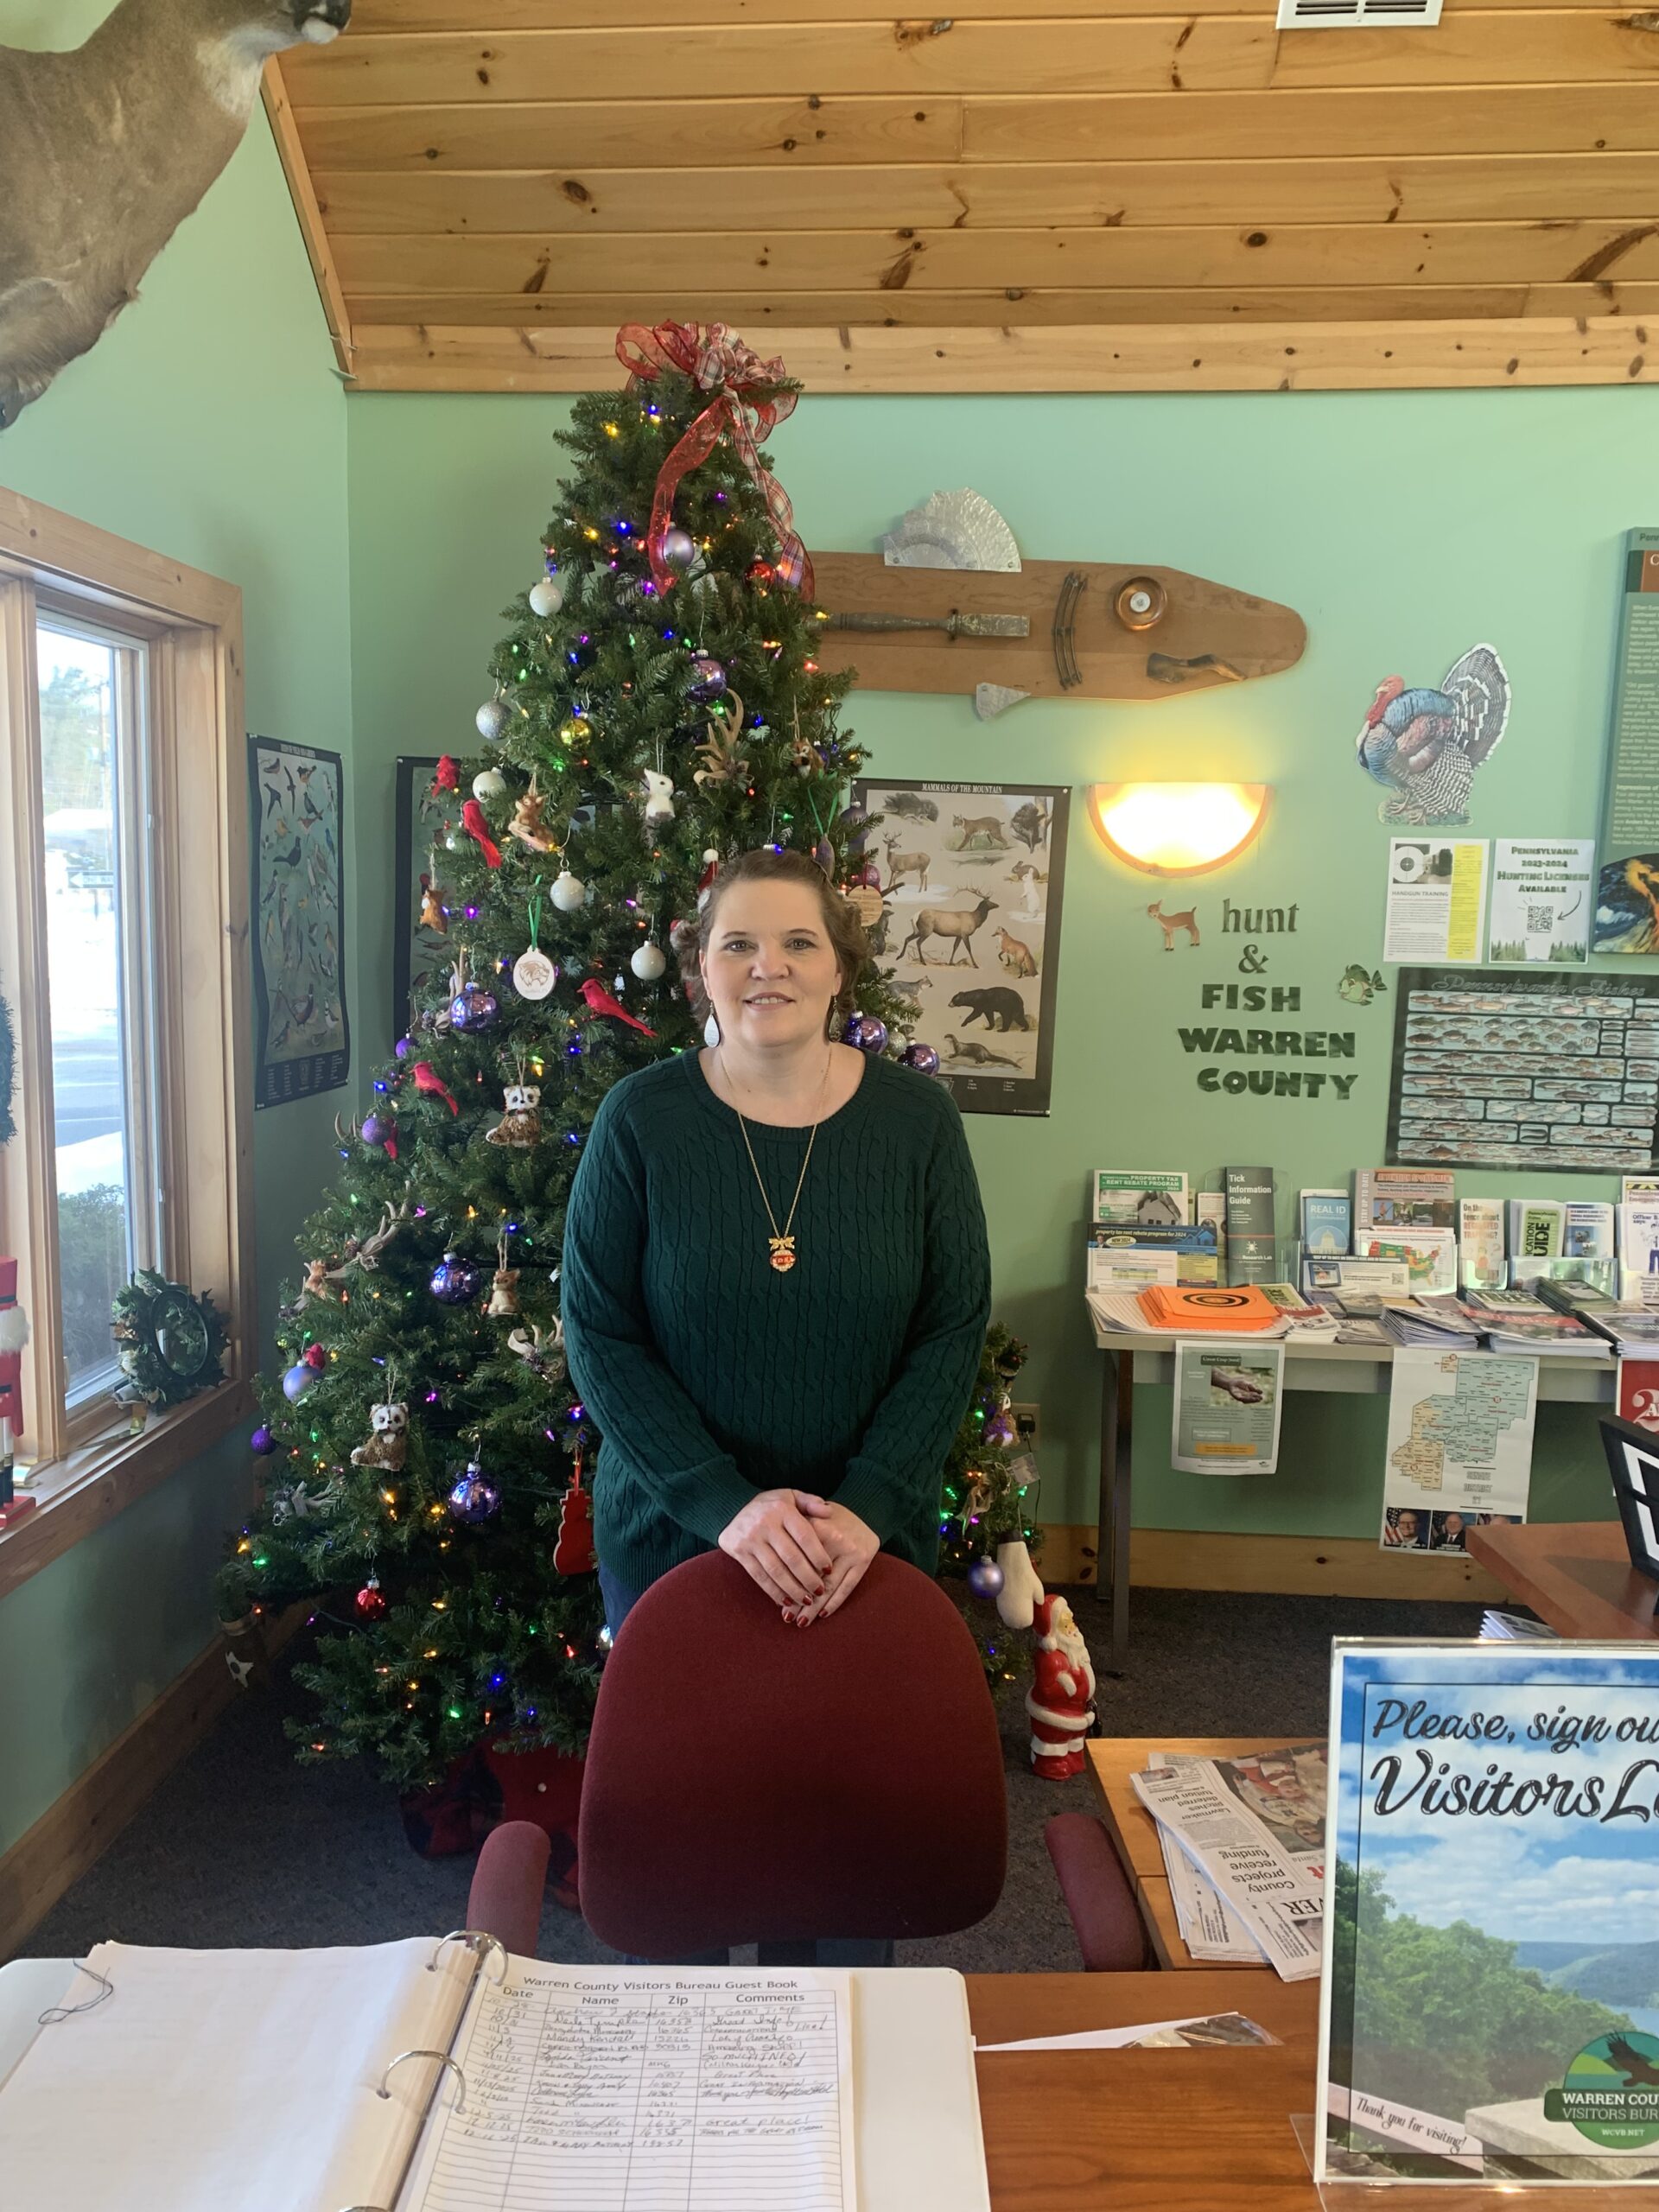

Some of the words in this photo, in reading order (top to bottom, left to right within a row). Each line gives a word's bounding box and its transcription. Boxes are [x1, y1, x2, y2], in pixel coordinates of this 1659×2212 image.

[921, 783, 950, 791] MAMMALS
[950, 784, 959, 792] OF
[960, 785, 971, 793] THE
[972, 785, 1002, 794] MOUNTAIN
[1511, 846, 1579, 855] PENNSYLVANIA
[1497, 871, 1542, 880] HUNTING
[1221, 899, 1300, 933] hunt
[1238, 944, 1269, 974] &
[1431, 975, 1568, 995] Pennsylvania
[1572, 979, 1645, 996] Fishes
[1202, 983, 1300, 1012] FISH
[1178, 1027, 1355, 1058] WARREN
[1197, 1067, 1358, 1100] COUNTY
[1229, 1174, 1245, 1183] Tick
[1229, 1185, 1272, 1193] Information
[1229, 1196, 1251, 1205] Guide
[1310, 1205, 1334, 1214] REAL
[1336, 1205, 1346, 1214] ID
[1372, 1699, 1516, 1744] Please,
[1528, 1705, 1611, 1754] sign
[1370, 1749, 1605, 1818] Visitors
[1600, 1759, 1659, 1823] L
[1158, 1793, 1179, 1803] plan
[1181, 1808, 1230, 1820] Lawmaker
[1218, 1849, 1270, 1859] funding
[1230, 1859, 1277, 1871] receive
[1231, 1868, 1286, 1884] projects
[1248, 1880, 1294, 1893] County
[523, 1977, 569, 1988] Warren
[574, 1981, 619, 1992] County
[624, 1981, 671, 1990] Visitors
[503, 1987, 534, 1999] Date
[668, 1996, 689, 2005] Zip
[736, 1994, 804, 2003] Comments
[1561, 2092, 1625, 2106] WARREN
[1628, 2092, 1659, 2106] COU
[1562, 2107, 1626, 2120] VISITORS
[1630, 2108, 1659, 2120] BUR
[1355, 2096, 1385, 2120] Thank
[1381, 2114, 1407, 2130] you
[1407, 2117, 1424, 2134] for
[1425, 2126, 1468, 2155] visiting!
[1601, 2128, 1645, 2138] WCVB.NET
